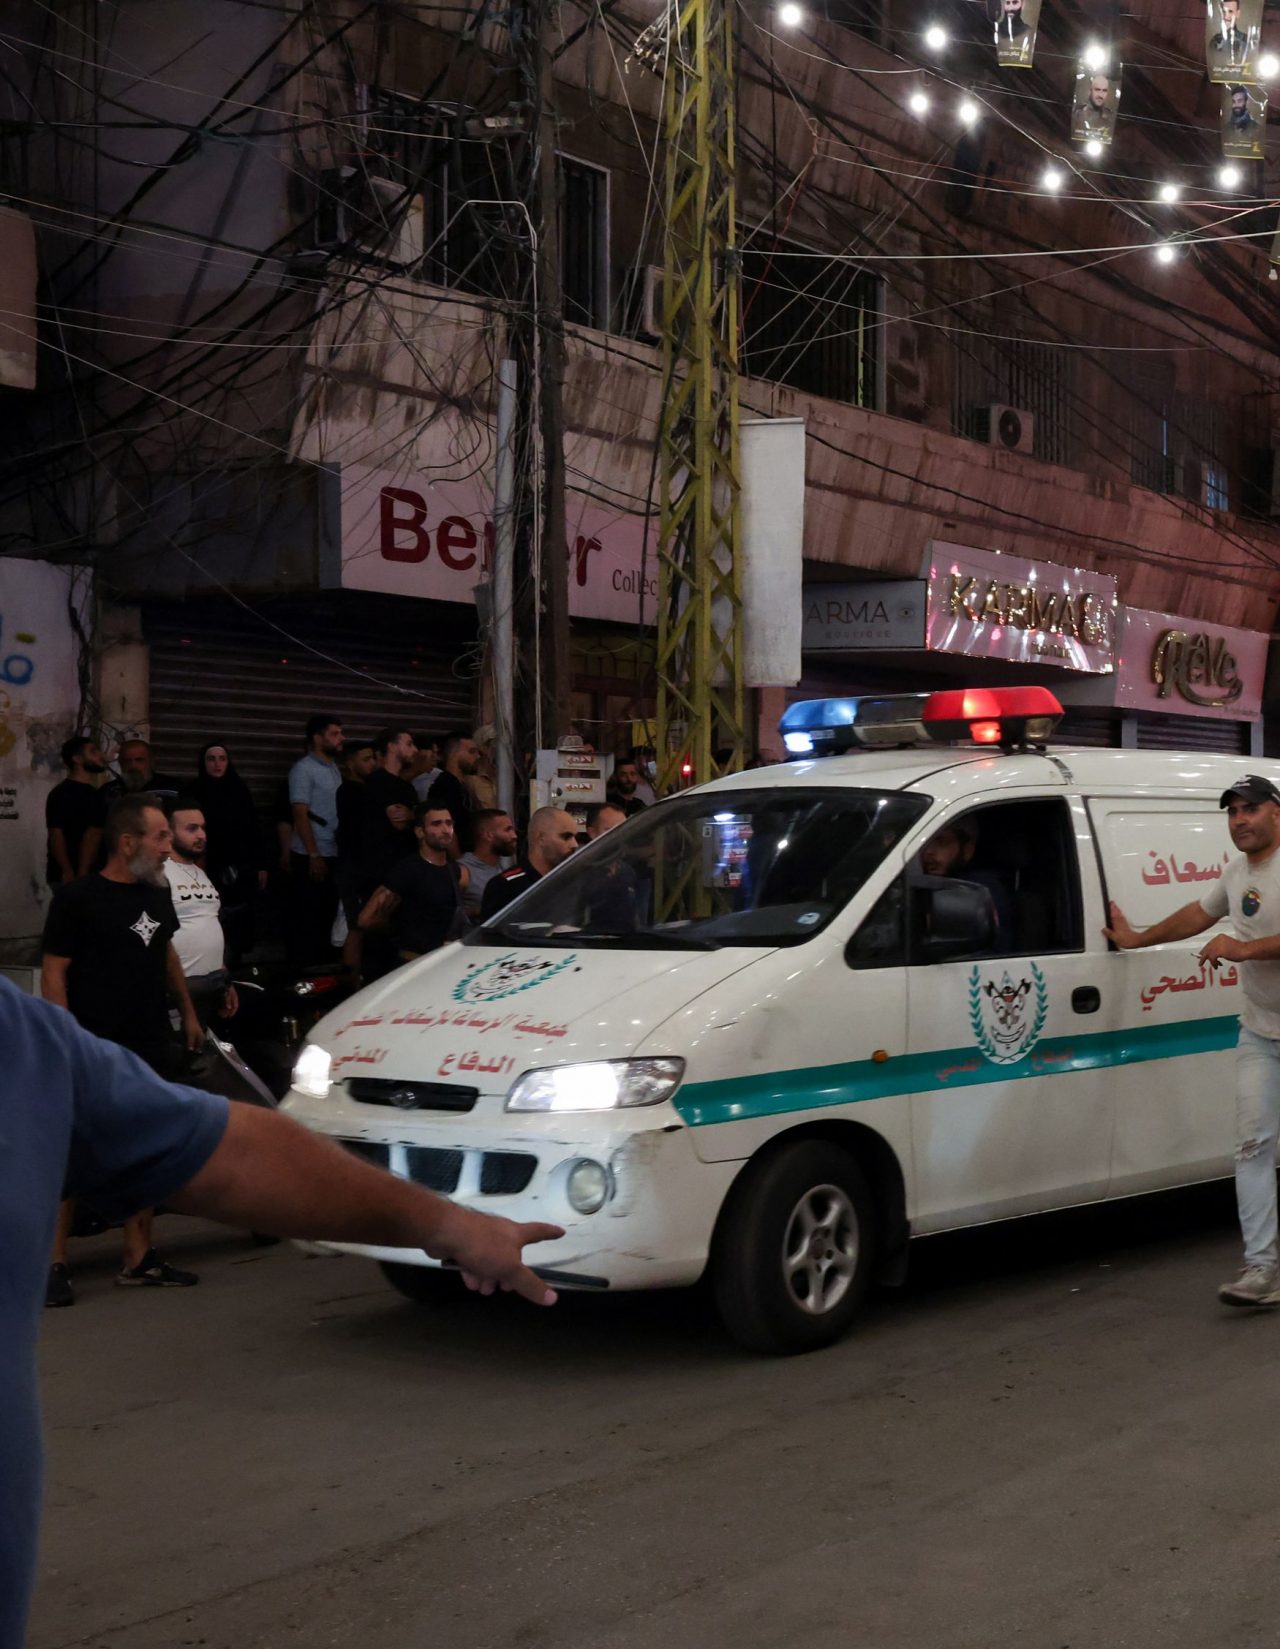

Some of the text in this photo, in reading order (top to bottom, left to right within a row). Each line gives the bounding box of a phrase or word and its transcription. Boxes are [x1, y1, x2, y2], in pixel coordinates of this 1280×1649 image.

[612, 569, 657, 596] Collec
[805, 601, 890, 624] ARMA
[1140, 964, 1214, 1011] الصحي
[437, 1050, 515, 1077] الدفاع
